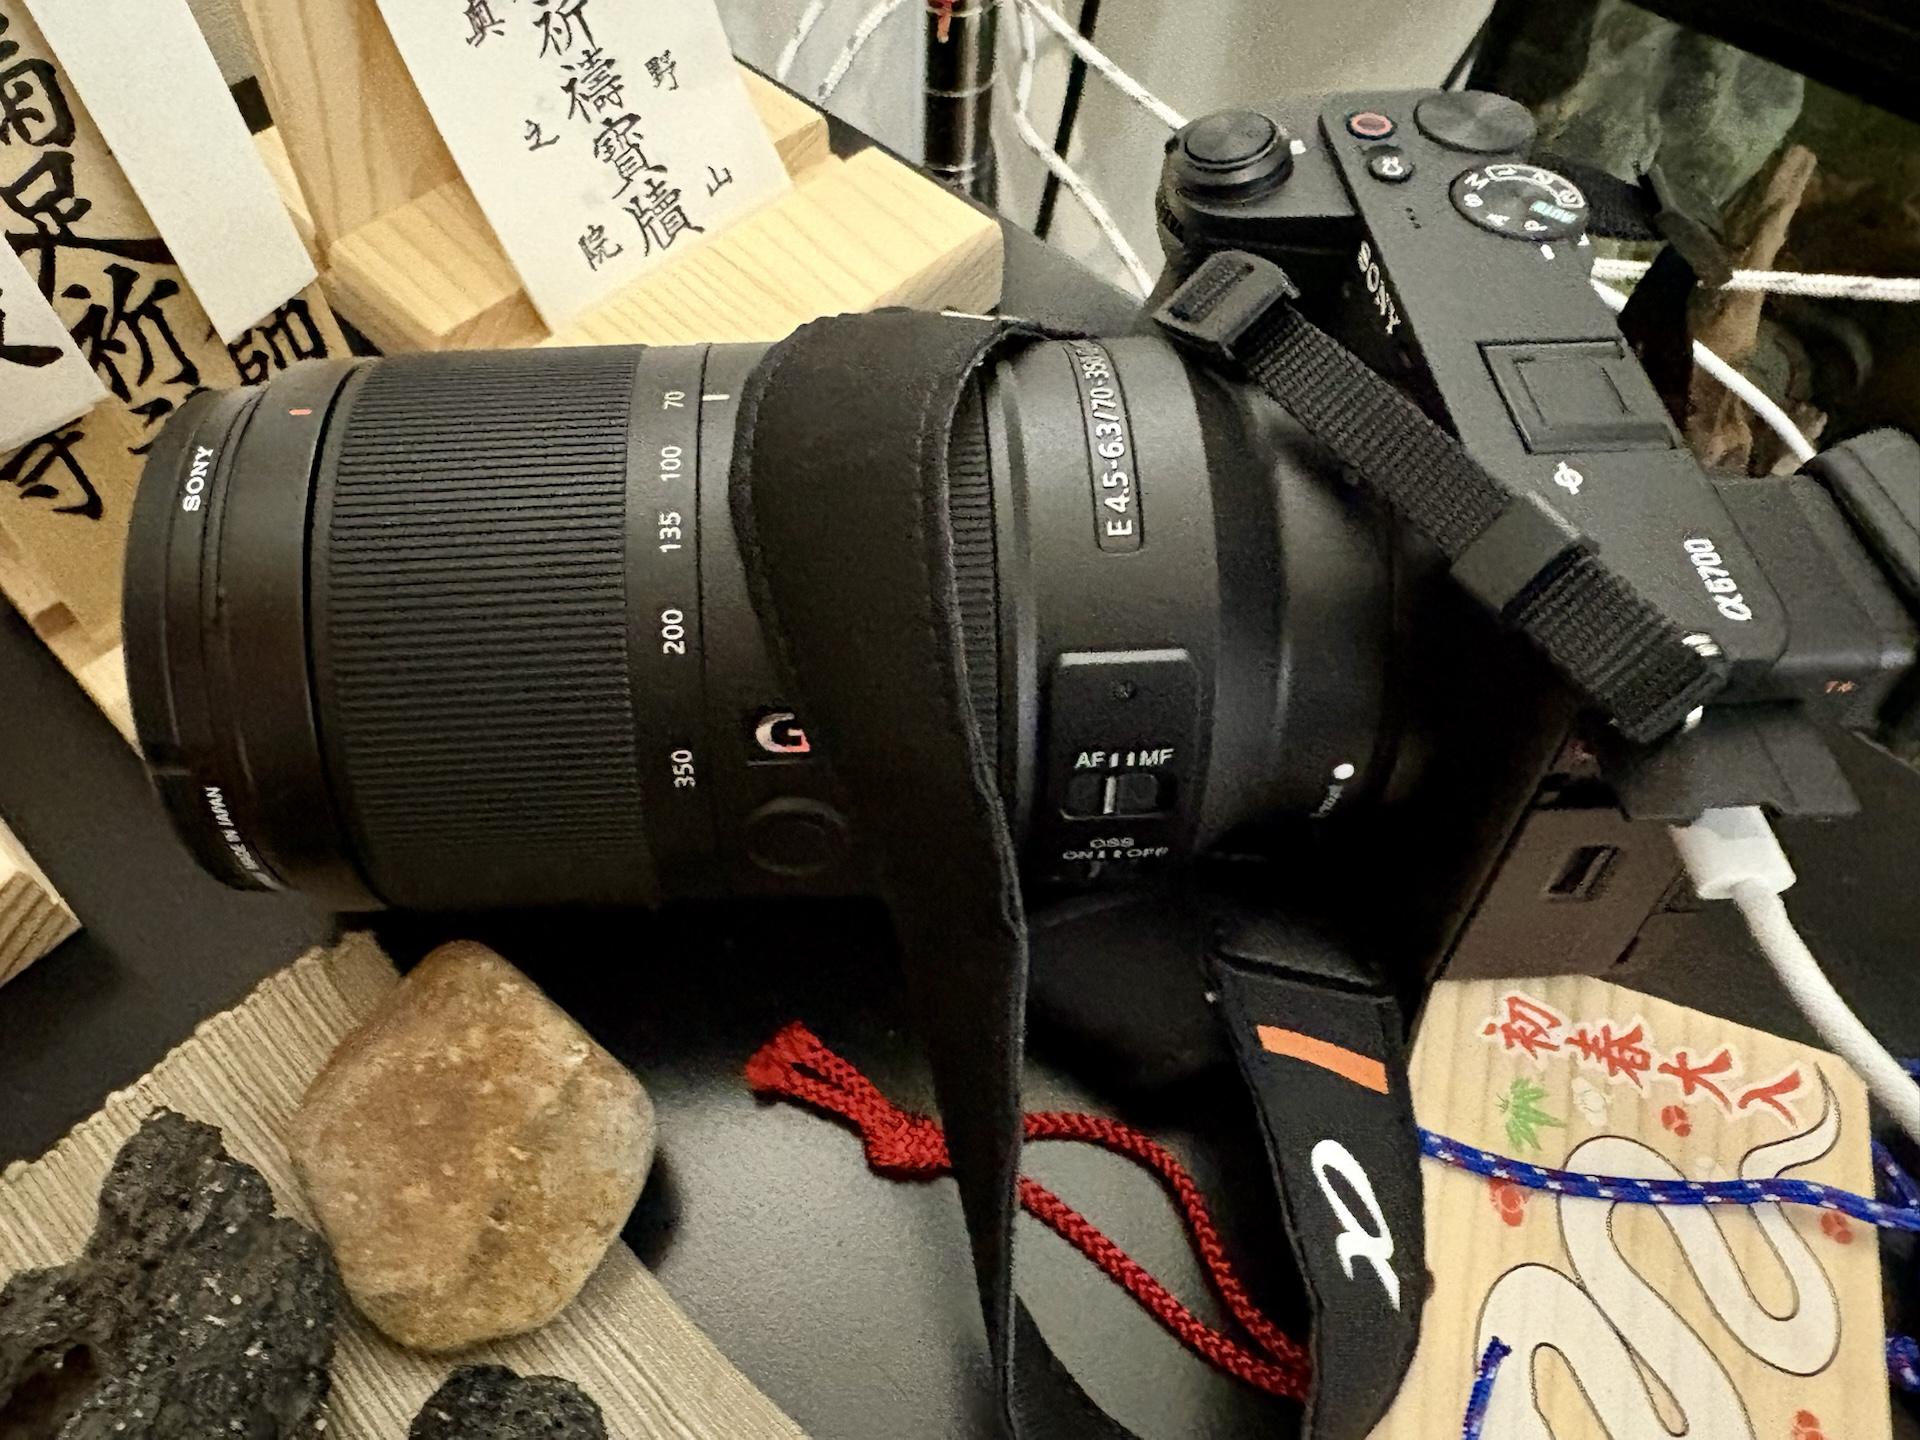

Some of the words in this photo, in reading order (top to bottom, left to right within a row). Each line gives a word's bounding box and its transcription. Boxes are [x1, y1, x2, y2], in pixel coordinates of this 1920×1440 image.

[663, 391, 686, 410] 70
[182, 445, 214, 512] SONY
[660, 445, 682, 482] 100
[658, 511, 682, 553] 135
[1106, 519, 1133, 537] E
[661, 609, 686, 655] 200
[755, 712, 811, 753] G
[670, 749, 696, 788] 350
[1074, 751, 1106, 769] AF
[1138, 748, 1175, 767] MF
